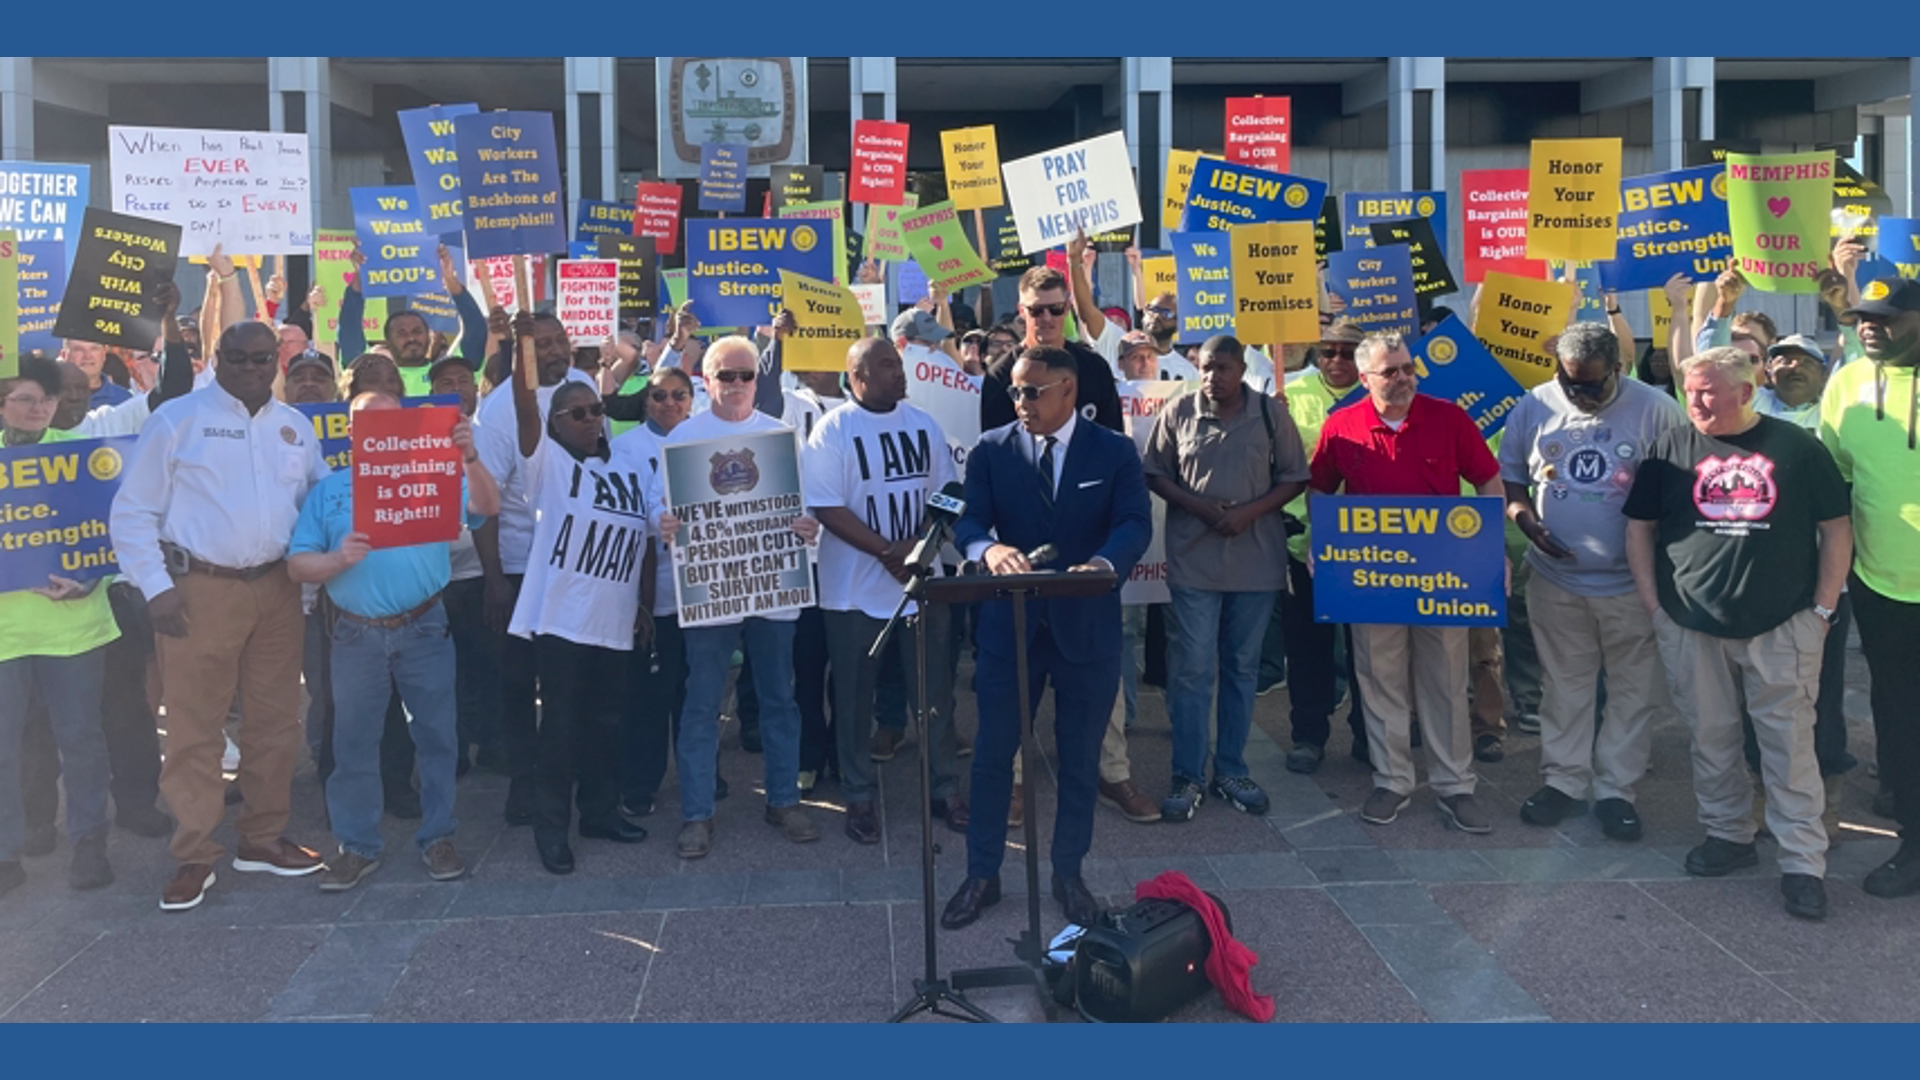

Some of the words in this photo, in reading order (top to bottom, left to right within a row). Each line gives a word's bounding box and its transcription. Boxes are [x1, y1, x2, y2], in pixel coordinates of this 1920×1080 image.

[1231, 115, 1285, 126] Collective
[119, 131, 181, 154] When
[491, 125, 522, 142] City
[857, 134, 904, 148] Collective
[1229, 131, 1287, 144] Bargaining
[477, 147, 538, 162] Workers
[855, 148, 904, 163] Bargaining
[953, 141, 986, 155] Honor
[1239, 148, 1250, 158] is
[1252, 147, 1277, 158] OUR
[184, 157, 250, 173] EVER
[873, 163, 894, 175] OUR
[958, 160, 985, 172] Your
[1042, 149, 1088, 182] PRAY
[1548, 159, 1604, 175] Honor
[1730, 160, 1830, 183] MEMPHIS
[0, 171, 78, 197] OGETHER
[482, 171, 507, 186] Are
[511, 169, 539, 183] The
[950, 177, 998, 191] Promises
[1209, 168, 1281, 201] IBEW
[468, 193, 540, 209] Backbone
[542, 191, 557, 205] of
[1055, 178, 1091, 206] FOR
[1469, 190, 1530, 203] Collectiv
[1553, 186, 1596, 203] Your
[30, 198, 67, 225] CAN
[377, 197, 409, 211] We
[1190, 194, 1257, 220] Justice.
[1357, 198, 1414, 218] IBEW
[369, 219, 423, 235] Want
[475, 213, 555, 231] Memphis!!!
[1037, 199, 1119, 240] MEMPHIS
[1533, 213, 1613, 230] Promises
[1617, 218, 1690, 239] ustice.
[94, 227, 167, 253] Workers
[708, 227, 787, 252] IBEW
[1481, 227, 1493, 240] is
[1496, 226, 1527, 239] OUR
[1755, 233, 1801, 251] OUR
[381, 245, 420, 260] Our
[1191, 242, 1218, 257] We
[1248, 243, 1299, 258] Honor
[107, 250, 146, 271] City
[692, 260, 770, 277] Justice.
[1357, 259, 1383, 272] City
[1741, 256, 1821, 281] UNIONS
[367, 266, 437, 286] MOU's
[1188, 267, 1230, 281] Want
[1255, 269, 1294, 286] Your
[1347, 276, 1398, 290] Workers
[100, 274, 142, 294] With
[560, 281, 616, 293] FIGHTING
[89, 296, 142, 317] Stand
[565, 295, 585, 306] for
[588, 295, 611, 306] the
[1195, 291, 1227, 305] Our
[1239, 297, 1314, 313] Promises
[1374, 294, 1398, 305] The
[1497, 291, 1553, 316] Honor
[561, 309, 614, 321] MIDDLE
[806, 299, 842, 316] Your
[94, 318, 122, 335] We
[564, 325, 611, 337] CLASS
[1500, 319, 1540, 341] Your
[362, 433, 452, 453] Collective
[853, 436, 870, 481] I
[879, 429, 931, 478] AM
[358, 458, 456, 479] Bargaining
[377, 485, 392, 500] is
[398, 483, 439, 499] OUR
[569, 462, 583, 498] I
[589, 470, 646, 518] AM
[374, 506, 442, 525] Right!!!
[672, 500, 722, 523] WE'VE
[724, 494, 800, 518] WITHSTOOD
[866, 494, 881, 535] A
[1338, 507, 1440, 535] IBEW
[690, 520, 732, 542] 4.6%
[550, 513, 574, 569] A
[574, 520, 643, 584] MAN
[687, 535, 760, 564] PENSION
[762, 531, 806, 552] CUTS
[1319, 544, 1418, 565] Justice.
[686, 564, 719, 585] BUT
[722, 560, 749, 579] WE
[751, 551, 798, 574] CAN'T
[708, 573, 781, 600] SURVIVE
[1353, 568, 1469, 593] Strength.
[682, 597, 751, 623] WITHOUT
[754, 593, 774, 611] AN
[1416, 597, 1498, 618] Union.
